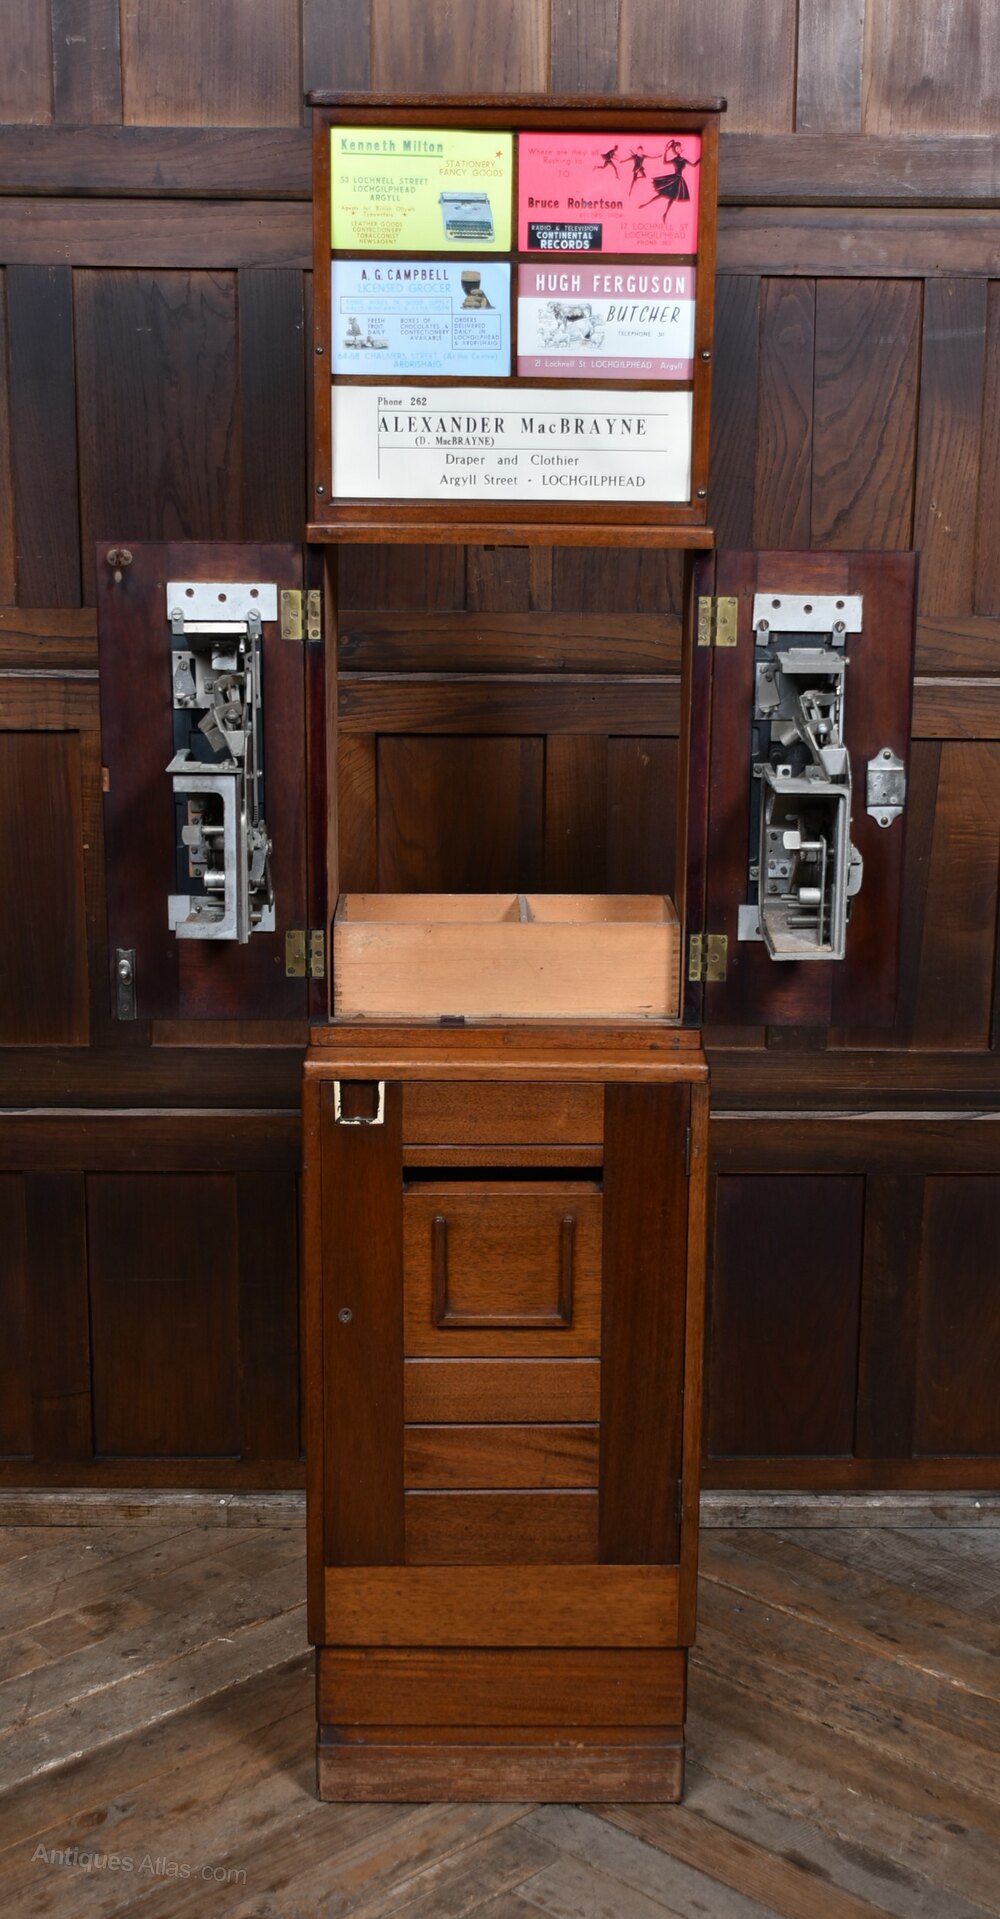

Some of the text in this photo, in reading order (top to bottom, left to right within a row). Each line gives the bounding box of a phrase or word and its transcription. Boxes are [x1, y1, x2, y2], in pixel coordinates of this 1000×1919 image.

[341, 139, 443, 152] Kenneth Milton
[446, 160, 496, 168] STATIONERY
[439, 168, 503, 177] FANCY GOODS
[353, 176, 394, 184] LOCHNELL
[399, 177, 429, 185] STREET
[353, 185, 416, 193] LOCHGILPHEAD
[370, 194, 401, 202] ARGYLL
[528, 197, 623, 209] Bruce Robertson
[536, 231, 593, 240] CONTINENTAL
[540, 239, 590, 249] RECORDS
[361, 269, 449, 281] A. G. CAMPBELL
[408, 283, 451, 293] GROCER
[536, 274, 685, 294] HUGH FERGUSON
[606, 305, 681, 323] BUTCHER
[545, 360, 575, 368] Lochnell
[591, 361, 652, 369] LOCHGILPHEAD
[660, 361, 683, 371] Argyll
[378, 397, 428, 406] Phone 262
[378, 416, 647, 435] ALEXANDER MacBRAYNE
[415, 436, 495, 447] (D. MacBRAYNE)
[445, 454, 579, 466] Draper and Clothier
[440, 474, 476, 487] Argyll
[484, 474, 518, 486] Street
[542, 475, 646, 487] LOCHGILPHEAD
